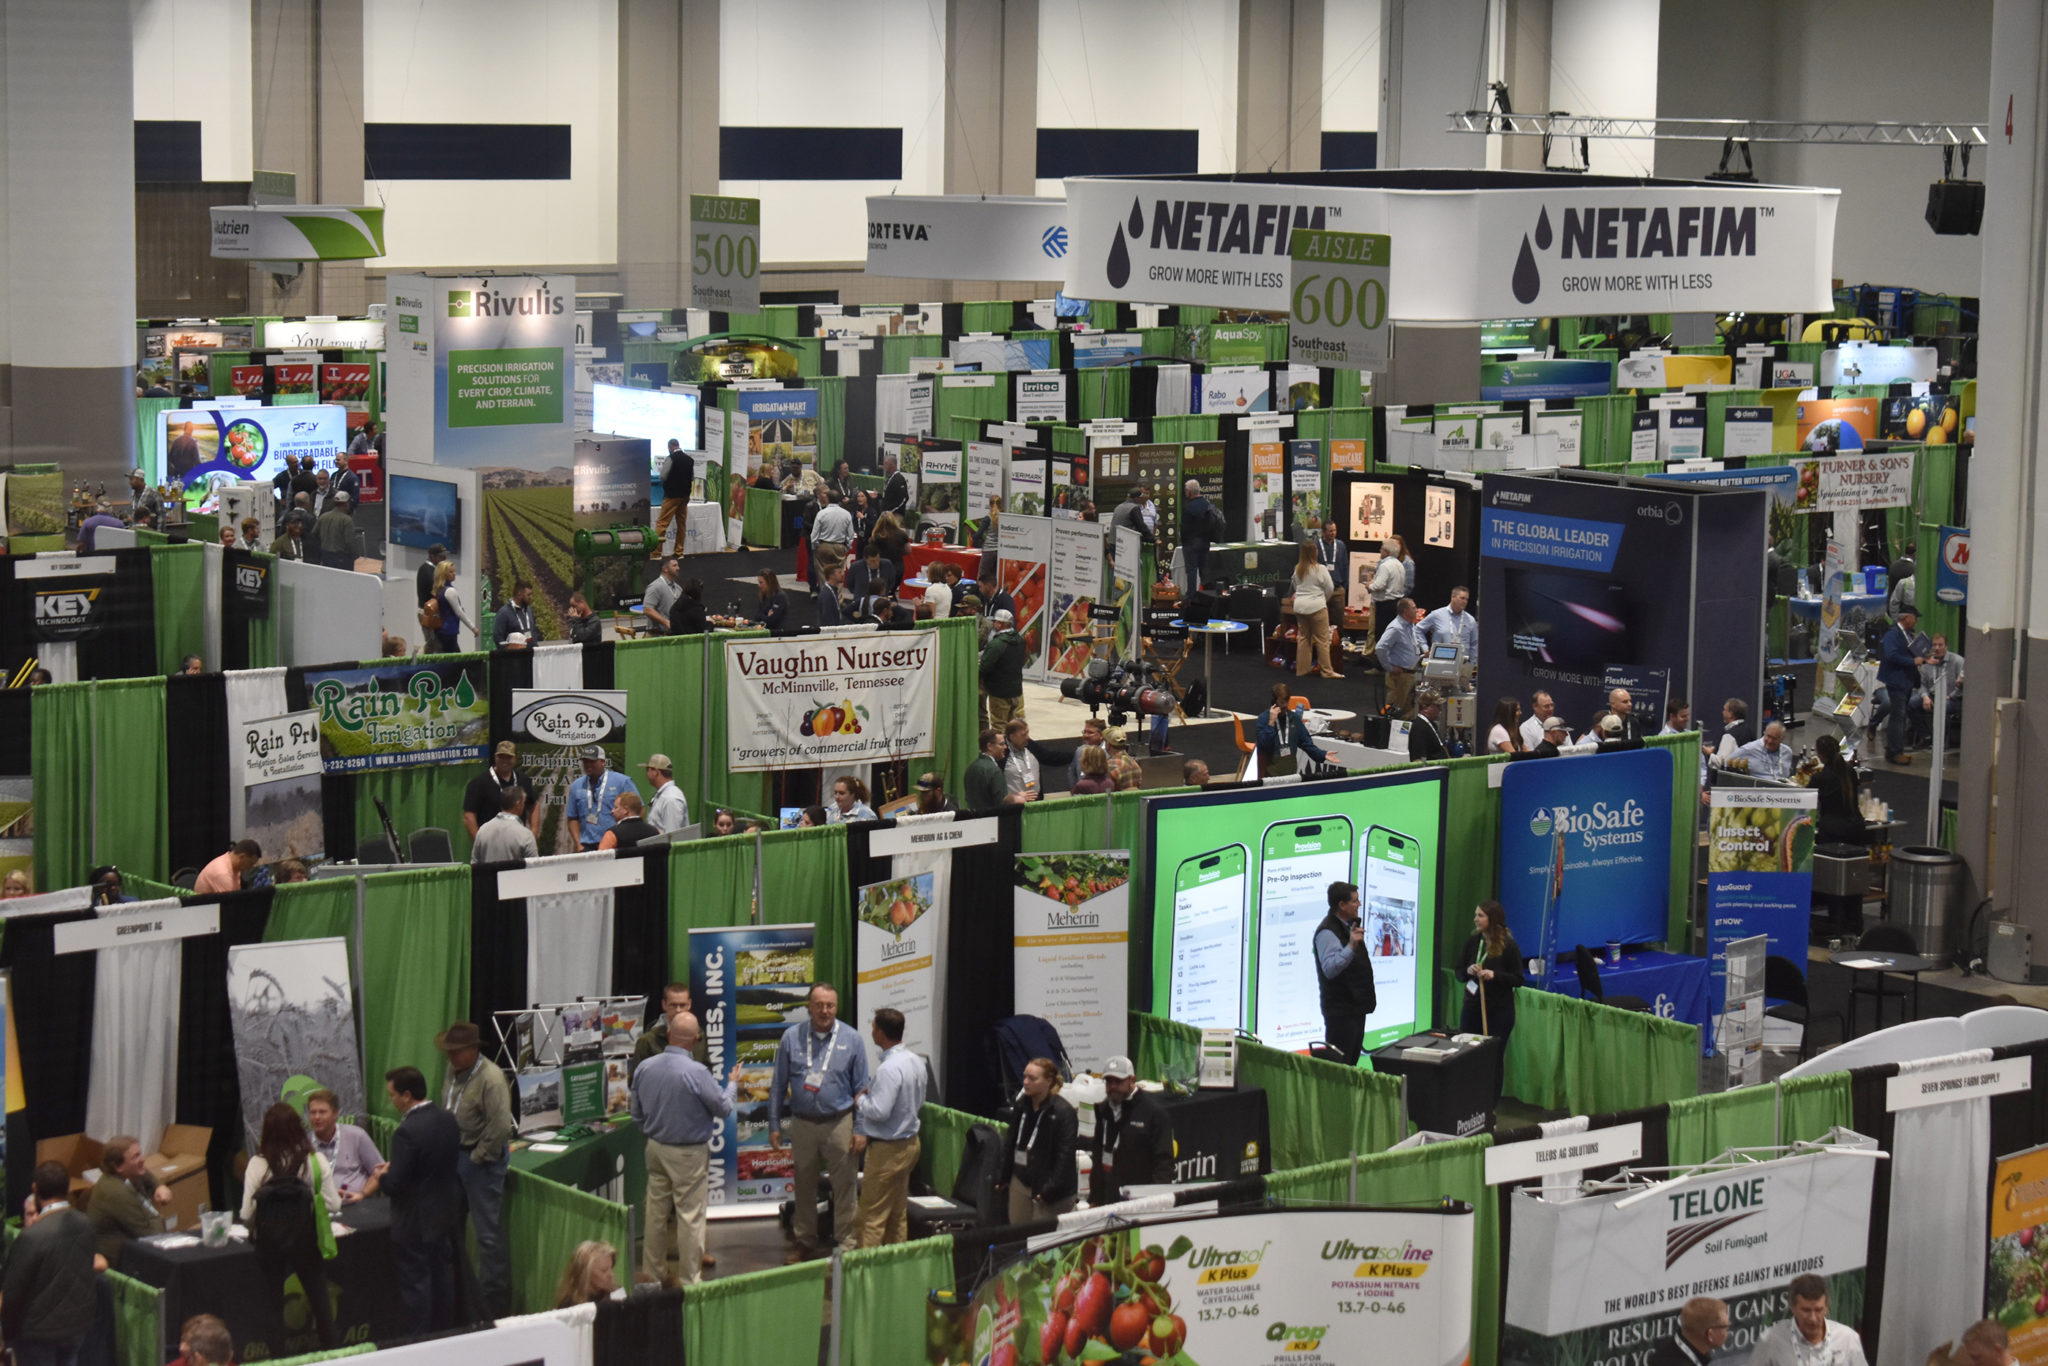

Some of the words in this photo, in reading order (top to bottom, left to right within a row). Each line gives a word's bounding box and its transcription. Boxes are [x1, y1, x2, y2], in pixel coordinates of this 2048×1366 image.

[700, 200, 749, 221] AISLE
[1150, 200, 1326, 256] NETAFIM
[1561, 206, 1757, 259] NETAFIM
[1305, 234, 1375, 261] AISLE
[692, 232, 758, 280] 500
[1149, 264, 1183, 282] GROW
[1185, 267, 1219, 285] MORE
[1221, 269, 1251, 287] WITH
[1254, 271, 1283, 289] LESS
[1562, 276, 1601, 293] GROW
[1605, 275, 1642, 292] MORE
[1644, 274, 1679, 290] WITH
[1681, 273, 1713, 289] LESS
[692, 284, 731, 298] Southeast
[475, 289, 565, 317] Rivulis
[1293, 274, 1387, 331] 600
[1291, 335, 1347, 352] Southeast
[1300, 348, 1349, 363] regional
[457, 364, 503, 374] PRECISION
[504, 361, 554, 372] IRRIGATION
[1775, 370, 1796, 379] UGA
[472, 375, 522, 386] SOLUTIONS
[523, 374, 540, 383] FOR
[1023, 383, 1059, 391] irritec
[458, 389, 485, 398] EVERY
[487, 388, 512, 397] CROP,
[513, 386, 553, 396] CLIMATE,
[1209, 390, 1227, 400] Rabo
[475, 400, 496, 409] AND
[497, 398, 536, 408] TERRAIN.
[581, 464, 611, 475] Rivulis
[925, 461, 957, 472] RHYME
[1821, 460, 1865, 474] TURNER
[1867, 459, 1877, 470] &
[1011, 471, 1043, 481] VERIMARK
[1720, 478, 1743, 487] BETTER
[1743, 476, 1760, 485] WITH
[1839, 472, 1890, 486] NURSERY
[1499, 490, 1531, 503] NETAFIM
[1637, 506, 1663, 518] orbia
[1491, 519, 1515, 535] THE
[1517, 522, 1562, 541] GLOBAL
[1564, 528, 1609, 547] LEADER
[1491, 537, 1501, 548] IN
[1502, 539, 1549, 556] PRECISION
[1550, 545, 1602, 563] IRRIGATION
[236, 563, 267, 588] KEY
[35, 588, 101, 619] KEY
[36, 616, 87, 626] TECHNOLOGY
[736, 649, 829, 679] Vaughn
[836, 646, 928, 671] Nursery
[1533, 667, 1557, 681] GROW
[1558, 671, 1581, 684] MORE
[1604, 676, 1634, 687] FlexNet
[762, 679, 839, 695] McMinnville,
[845, 676, 905, 690] Tennessee
[312, 675, 402, 732] Rain
[533, 712, 571, 732] Rain
[366, 721, 457, 748] Irrigation
[555, 729, 597, 740] Irrigation
[247, 728, 285, 759] Rain
[788, 744, 802, 756] of
[804, 739, 869, 755] commercial
[870, 735, 891, 749] fruit
[375, 748, 479, 766] WWW.RAINPROIRRIGATION.COM
[522, 754, 581, 769] Helping
[1734, 794, 1765, 803] BioSafe
[1766, 795, 1801, 804] Systems
[1551, 799, 1645, 836] BioSafe
[910, 832, 935, 844] MEHERRIN
[936, 832, 943, 842] AG
[1718, 826, 1761, 838] Insect
[1583, 830, 1644, 852] Systems
[1718, 840, 1769, 852] Control
[1591, 859, 1614, 868] Always
[1614, 855, 1644, 866] Effective.
[567, 873, 579, 882] BWI
[1267, 875, 1289, 886] Pre-Op
[1289, 870, 1323, 883] Inspection
[1047, 912, 1099, 927] Meherrin
[116, 922, 152, 936] GREENPOINT
[153, 920, 163, 931] AG
[880, 938, 916, 959] Meherrin
[705, 945, 725, 996] INC.
[766, 1002, 784, 1010] Golf
[753, 1043, 779, 1052] Sports
[705, 1000, 728, 1153] COANIES,
[1921, 1081, 1939, 1094] SEVEN
[1940, 1078, 1963, 1092] SPRINGS
[1963, 1076, 1979, 1089] FARM
[1979, 1072, 2001, 1087] SUPPLY
[1457, 1111, 1486, 1135] Provision
[1558, 1147, 1567, 1159] AG
[1568, 1142, 1599, 1158] SOLUTIONS
[708, 1158, 726, 1205] BWI
[1668, 1177, 1765, 1221] TELONE
[1320, 1239, 1433, 1261] Ultrasoline
[1704, 1239, 1723, 1255] Soil
[1724, 1231, 1769, 1252] Fumigant
[1188, 1240, 1266, 1269] Ultrasol
[1208, 1271, 1218, 1282] K
[1220, 1268, 1249, 1280] Plus
[1368, 1264, 1380, 1276] K
[1383, 1264, 1412, 1277] Plus
[1197, 1286, 1224, 1298] WATER
[1225, 1283, 1261, 1295] SOLUBLE
[1331, 1280, 1381, 1289] POTASSIUM
[1383, 1281, 1421, 1290] NITRATE
[1603, 1298, 1621, 1314] THE
[1623, 1289, 1665, 1311] WORLD'S
[1667, 1284, 1690, 1301] BEST
[1692, 1275, 1730, 1297] DEFENSE
[1731, 1265, 1771, 1288] AGAINST
[1773, 1254, 1825, 1279] NEMATODES
[1202, 1293, 1255, 1305] CRYSTALLINE
[1363, 1290, 1395, 1298] IODINE
[1197, 1303, 1260, 1322] 13.7-0-46
[1337, 1301, 1406, 1314] 13.7-0-46
[1735, 1296, 1774, 1322] CAN
[1266, 1321, 1327, 1343] Qrop
[1274, 1354, 1303, 1364] PRILLS
[1304, 1353, 1321, 1363] FOR
